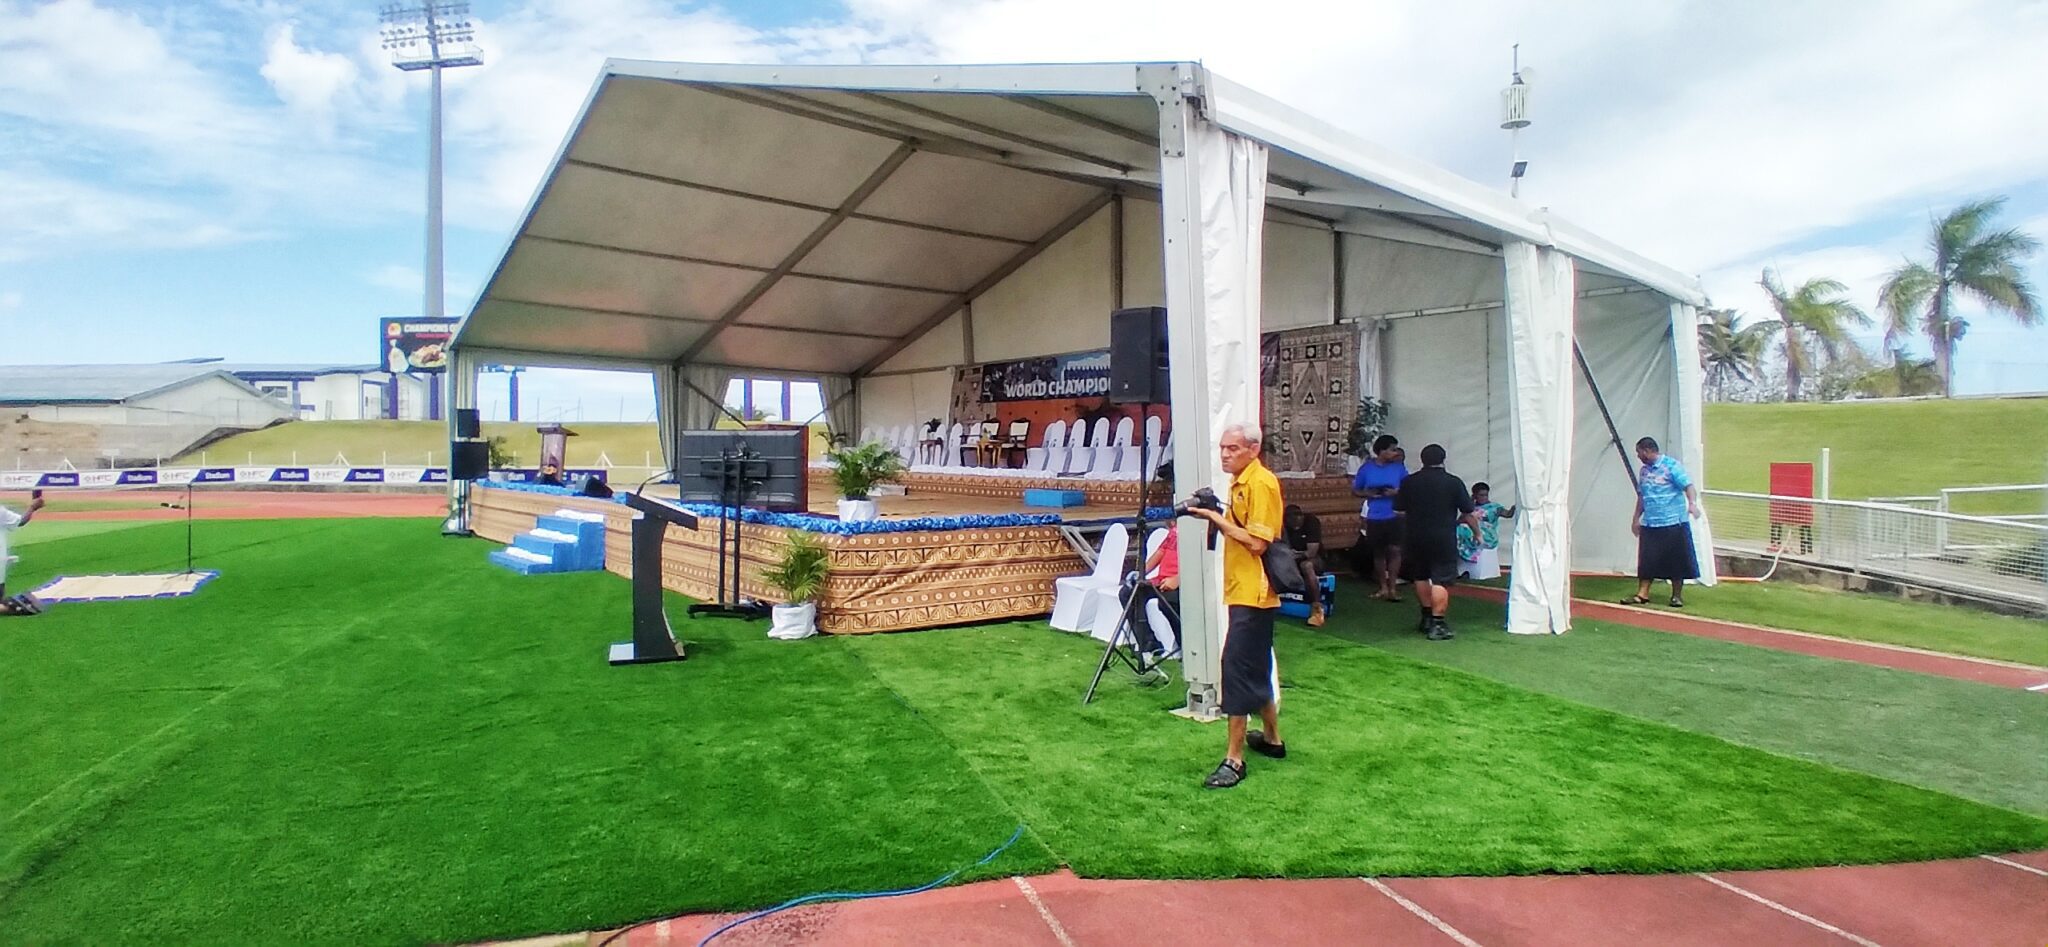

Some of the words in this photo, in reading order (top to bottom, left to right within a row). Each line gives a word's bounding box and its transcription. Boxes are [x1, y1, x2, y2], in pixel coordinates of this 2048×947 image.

[404, 323, 448, 333] CHAMPIONS
[1006, 381, 1047, 397] WORLD
[1048, 377, 1111, 396] CHAMPIO
[48, 476, 74, 484] Stadium
[127, 473, 153, 482] Stadium
[205, 471, 231, 480] Stadium
[280, 471, 305, 480] Stadium
[355, 471, 380, 480] Stadium
[431, 471, 447, 480] Stadi
